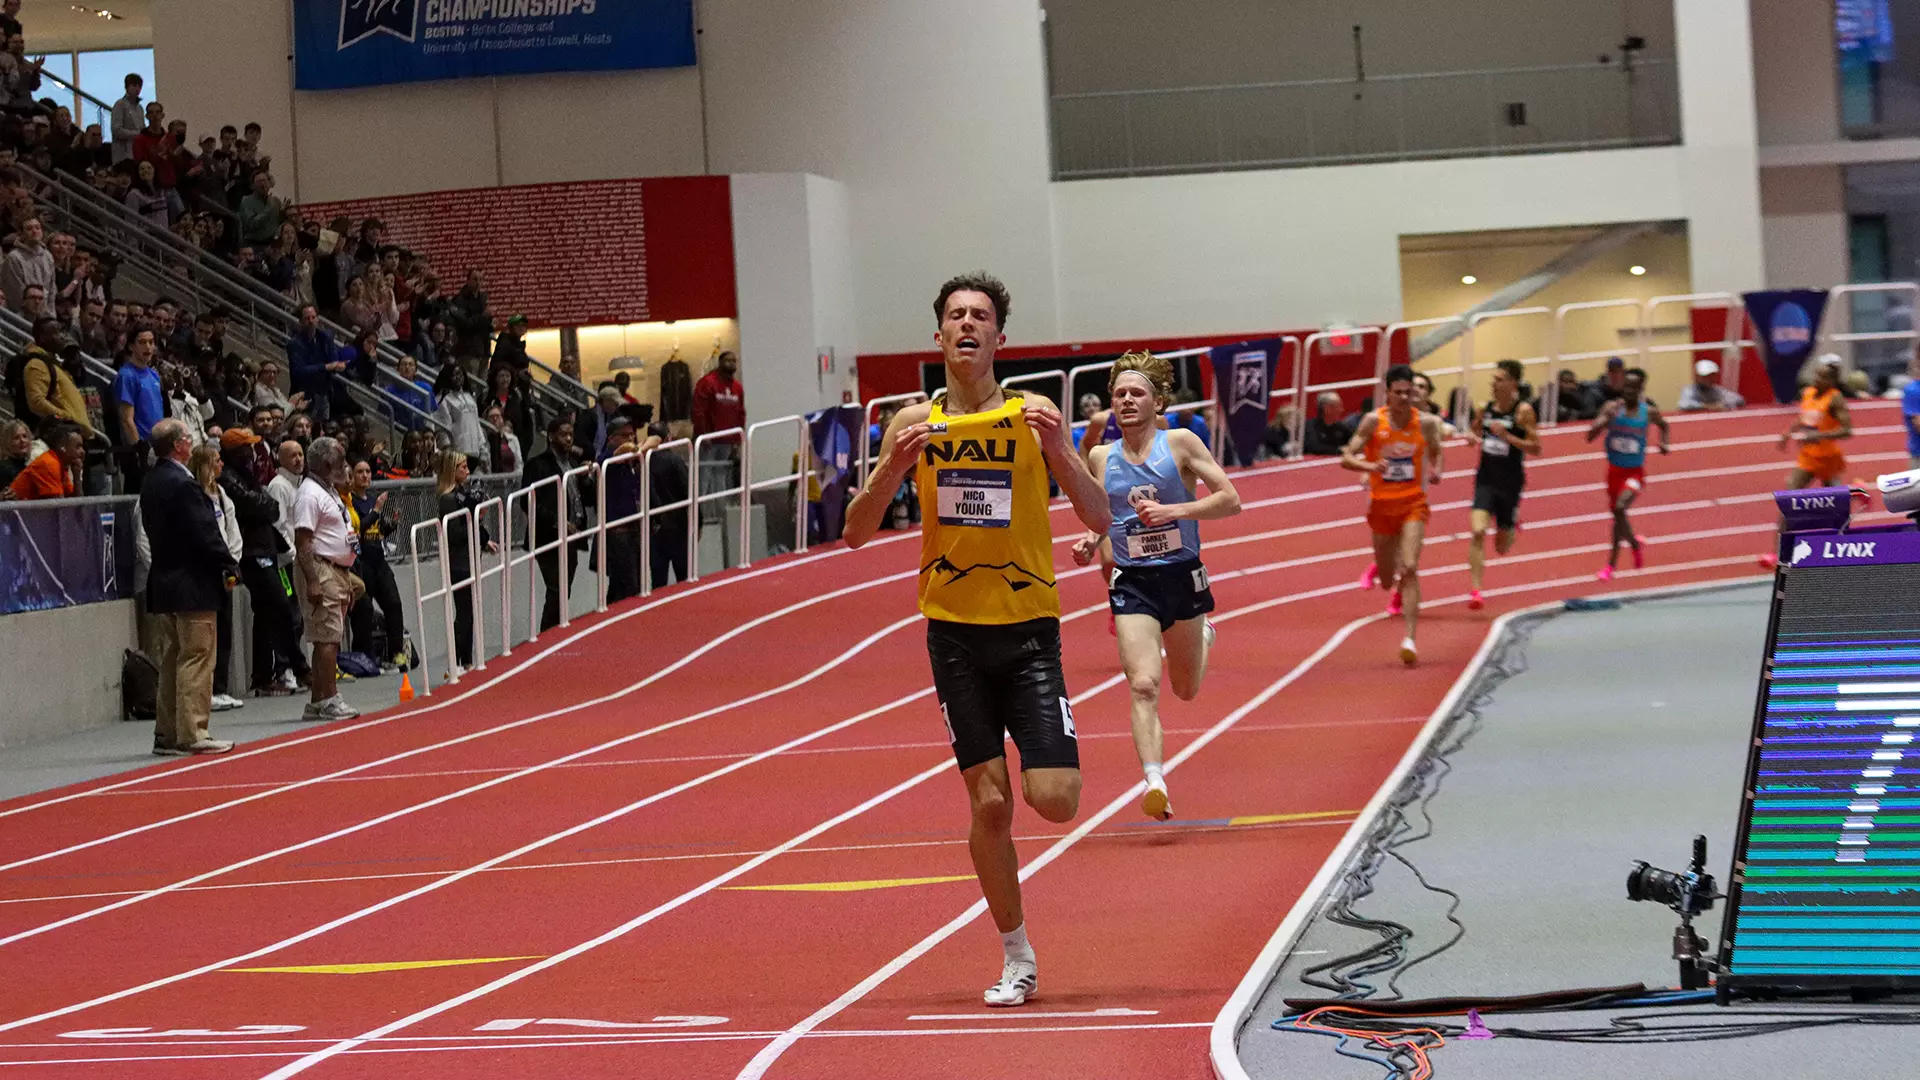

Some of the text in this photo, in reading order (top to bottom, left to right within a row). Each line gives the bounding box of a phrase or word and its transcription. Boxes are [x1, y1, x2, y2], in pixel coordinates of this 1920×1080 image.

[425, 0, 597, 23] CHAMPIONSHIPS
[424, 25, 465, 39] BOSTON
[498, 21, 535, 35] College
[536, 20, 555, 32] and
[422, 32, 612, 55] University of Massachusetts Lowell, Hosts
[924, 439, 1016, 466] NAU
[963, 490, 985, 501] NICO
[1791, 496, 1835, 510] LYNX
[955, 502, 992, 516] YOUNG
[1141, 533, 1167, 544] PARKER
[1141, 541, 1169, 554] WOLFE
[1822, 542, 1876, 559] LYNX
[471, 1015, 731, 1032] 2
[57, 1025, 307, 1038] 3
